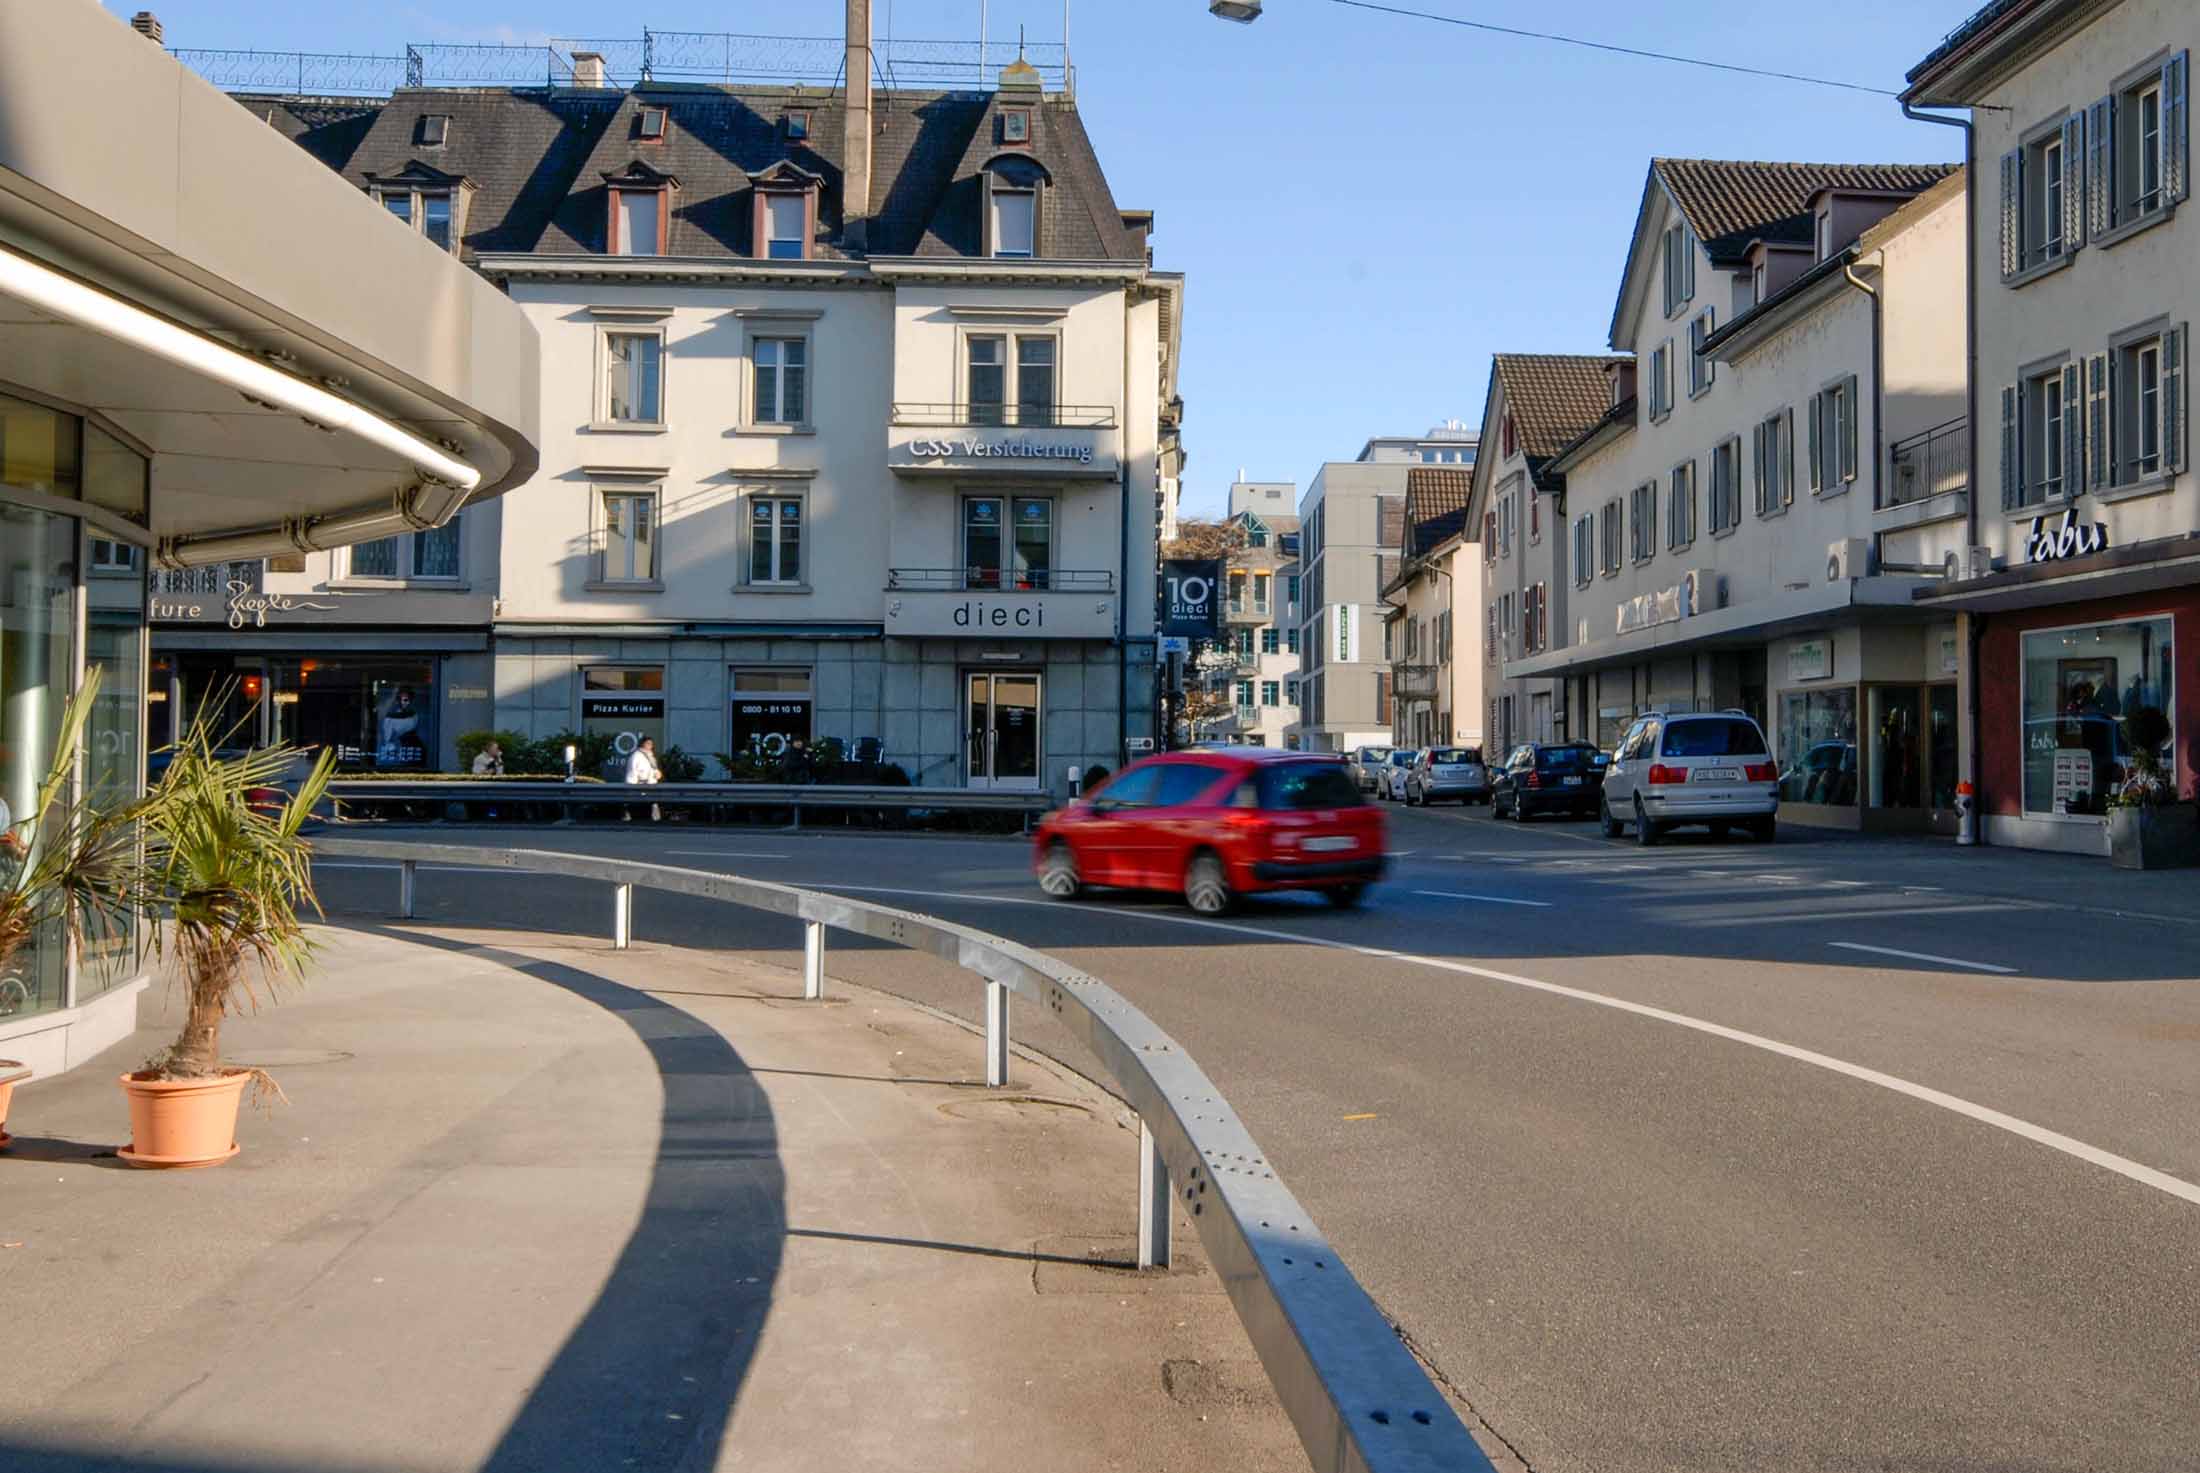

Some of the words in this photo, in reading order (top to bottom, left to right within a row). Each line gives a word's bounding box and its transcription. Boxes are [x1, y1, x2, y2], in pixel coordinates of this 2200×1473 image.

[909, 439, 953, 456] CSS
[963, 437, 1092, 463] Versicherung
[2023, 509, 2107, 562] tabu
[953, 602, 1043, 626] dieci
[1172, 603, 1209, 613] dieci
[593, 704, 618, 713] Pizza
[622, 704, 653, 713] Kurier
